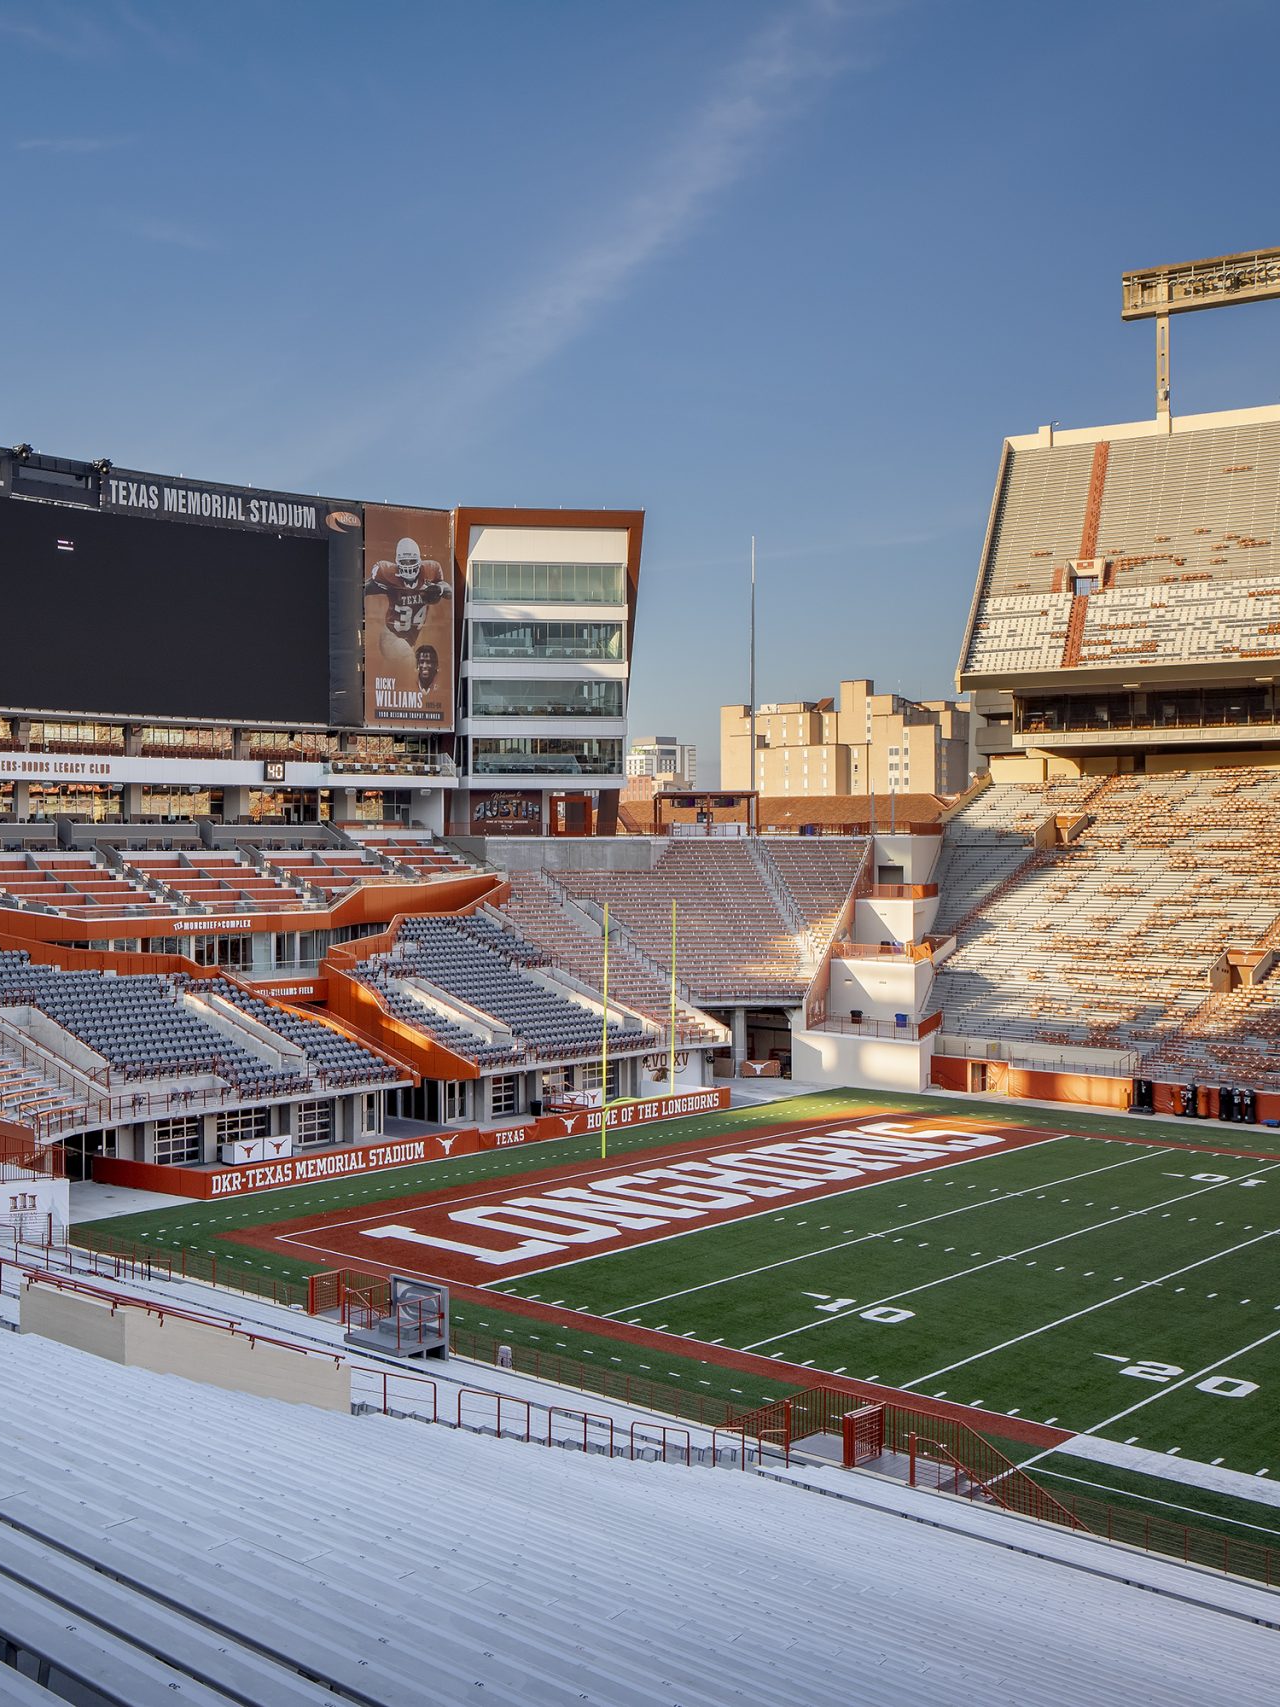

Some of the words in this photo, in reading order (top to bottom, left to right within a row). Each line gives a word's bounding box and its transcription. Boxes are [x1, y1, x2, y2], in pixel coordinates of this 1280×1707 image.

[109, 479, 159, 510] TEXAS
[163, 487, 245, 521] MEMORIAL
[249, 499, 316, 530] STADIUM
[401, 594, 423, 605] TEXA
[393, 604, 428, 632] 34
[375, 677, 396, 690] RICKY
[375, 690, 423, 708] WILLIAMS
[54, 762, 86, 774] LEGACY
[89, 763, 111, 774] CLUB
[267, 764, 283, 779] 40
[473, 799, 541, 822] AUSTIN
[221, 920, 251, 929] COMPLEX
[298, 986, 314, 995] FIELD
[672, 1052, 689, 1066] XV
[586, 1108, 618, 1129] HOME
[621, 1107, 634, 1123] OF
[638, 1103, 659, 1119] THE
[661, 1092, 719, 1116] LONGHORNS
[495, 1129, 525, 1145] TEXAS
[211, 1163, 293, 1195] DKR-TEXAS
[295, 1150, 366, 1180] MEMORIAL
[369, 1141, 425, 1167] STADIUM
[358, 1121, 1007, 1266] LONGHORNS
[814, 1298, 916, 1324] 10
[1119, 1360, 1261, 1398] 20
